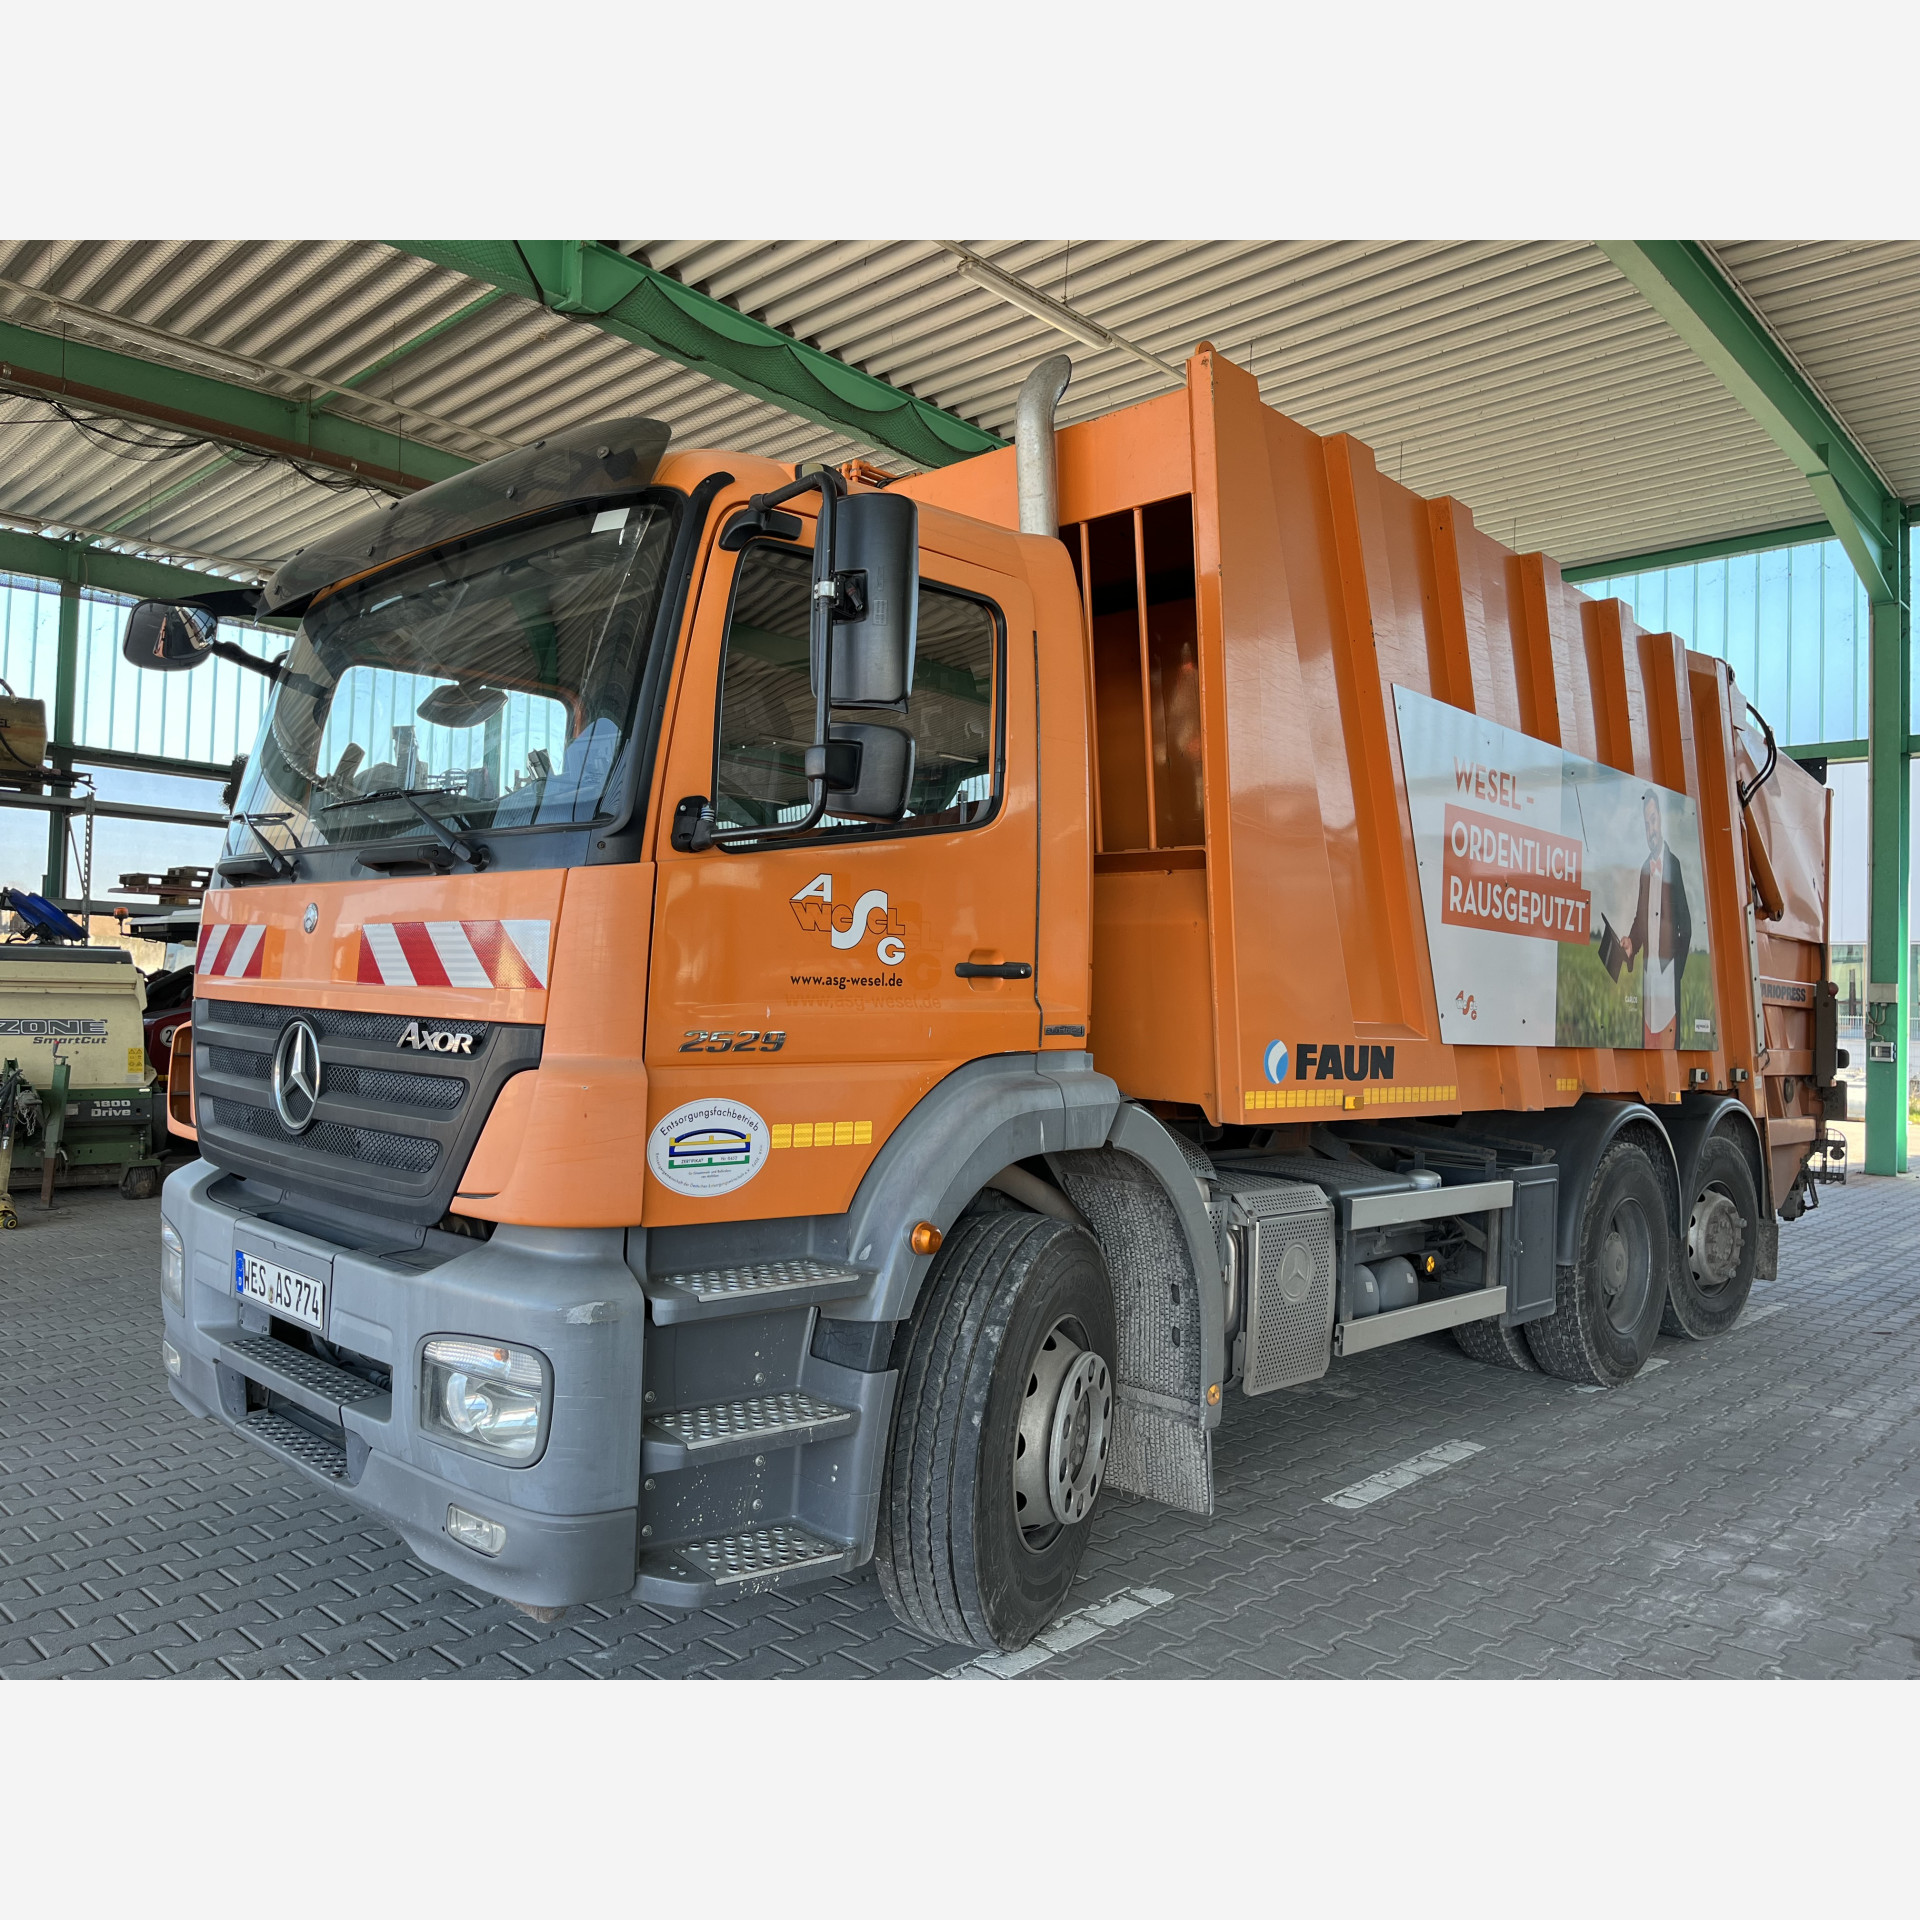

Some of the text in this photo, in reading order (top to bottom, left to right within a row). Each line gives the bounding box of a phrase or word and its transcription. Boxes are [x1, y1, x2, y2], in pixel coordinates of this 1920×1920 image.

[1454, 756, 1521, 811] WESEL
[1451, 821, 1577, 883] ORDENTLICH
[1450, 875, 1586, 932] RAUSGEPUTZT
[791, 973, 903, 990] www.asg-wesel.de
[33, 1036, 107, 1044] SmartCut
[679, 1030, 787, 1053] 2529
[1296, 1043, 1395, 1081] FAUN
[91, 1108, 131, 1117] Drive
[660, 1106, 759, 1136] Entsorgungsfachbetrieb
[244, 1258, 266, 1296] WES
[295, 1279, 319, 1320] 774
